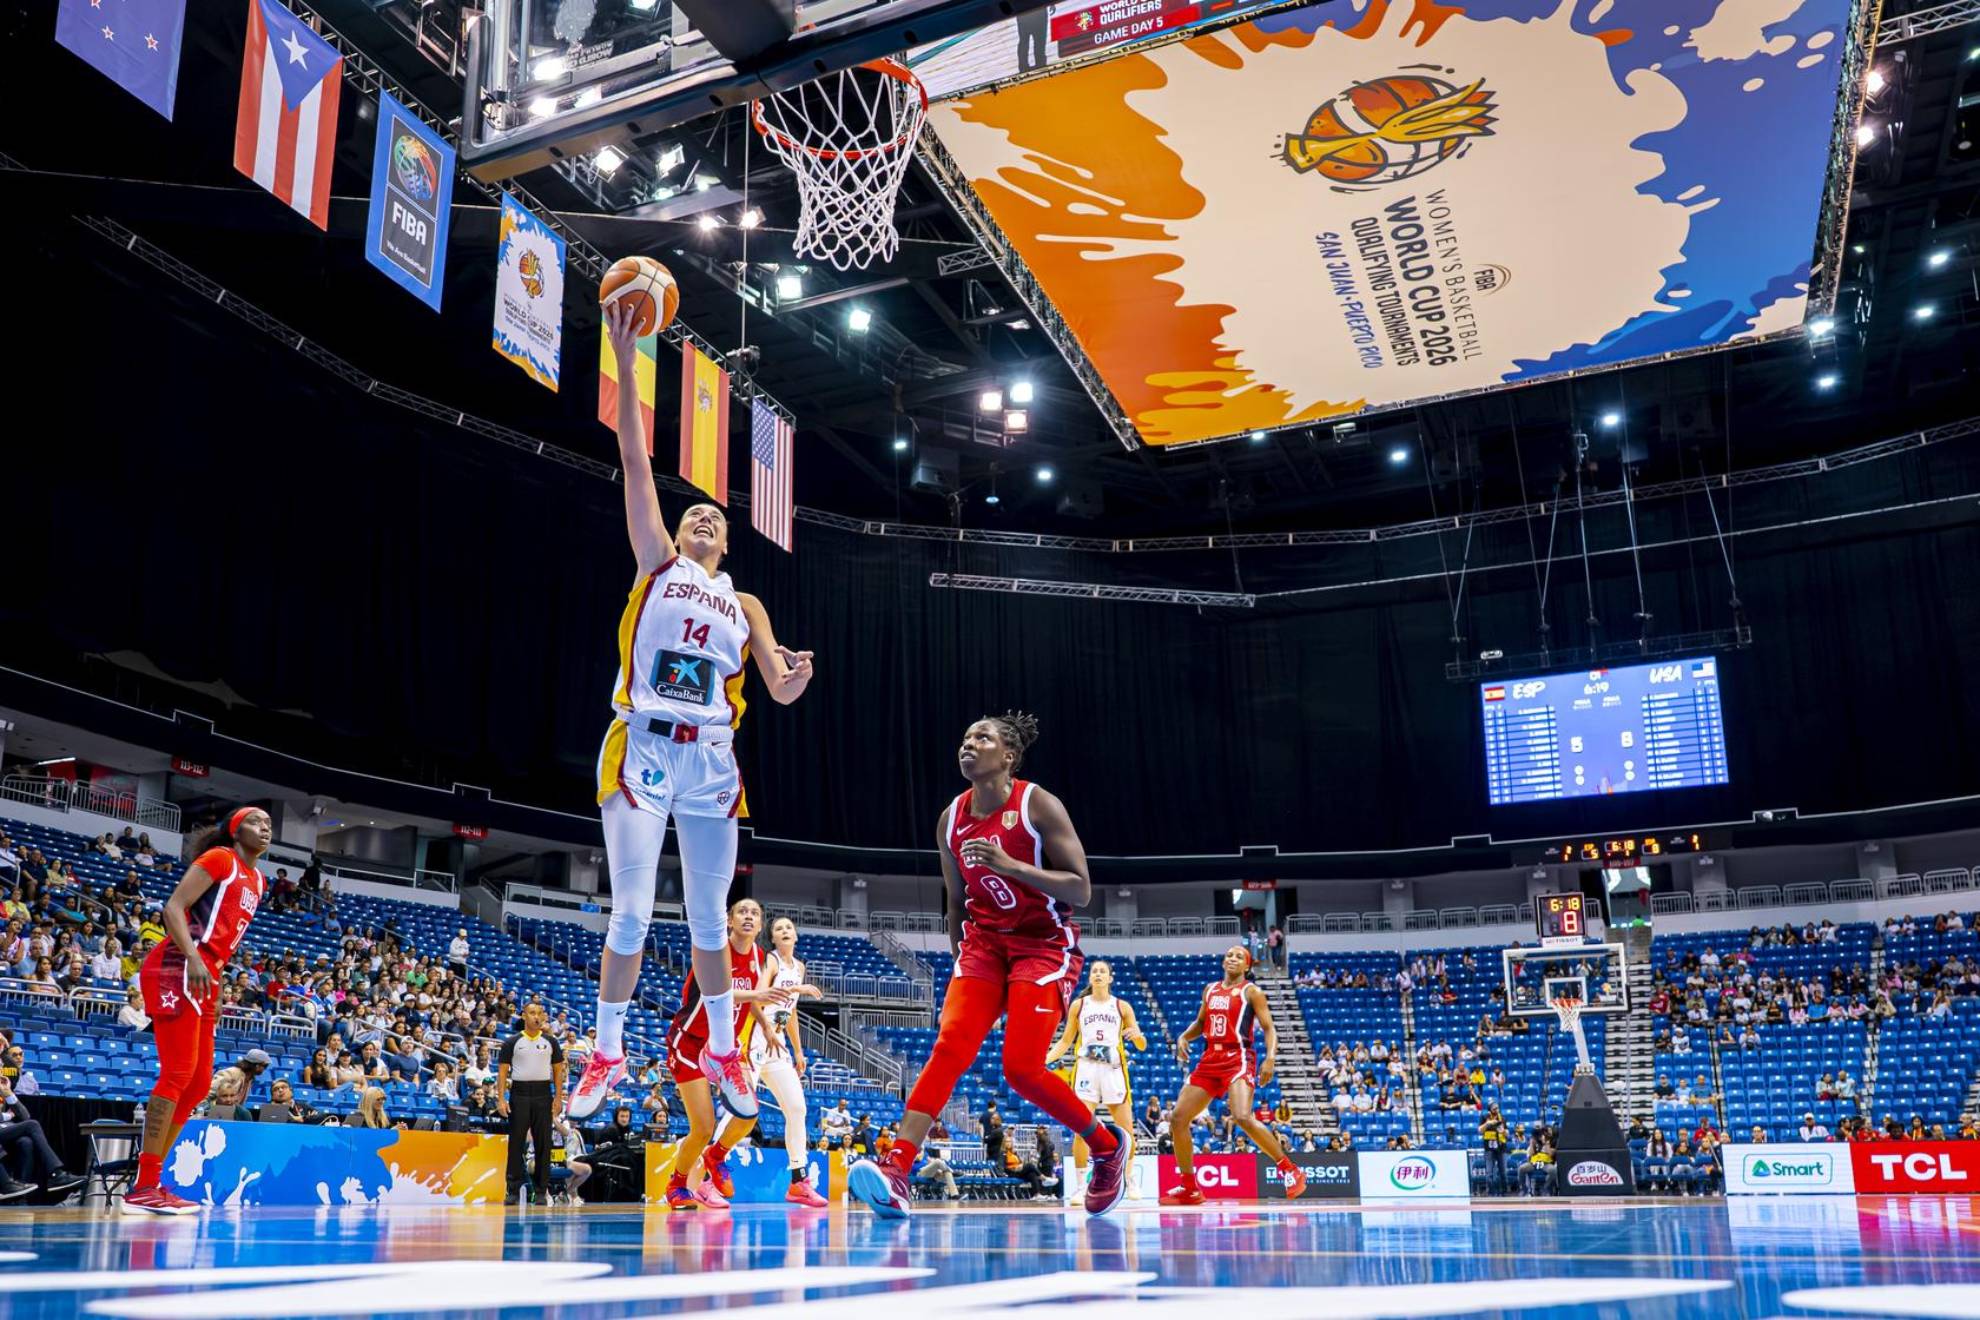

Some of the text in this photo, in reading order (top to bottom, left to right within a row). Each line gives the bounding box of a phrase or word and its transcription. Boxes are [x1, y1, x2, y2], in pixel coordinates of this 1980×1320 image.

[1100, 0, 1162, 25] QUALIFIERS
[1094, 16, 1164, 45] GAME DAY 5
[392, 201, 427, 246] FIBA
[1315, 231, 1346, 259] SAN
[1384, 195, 1458, 367] WORLD CUP 2026
[1424, 188, 1482, 361] WOMEN'S BASKETBALL
[1473, 268, 1497, 292] FIBA
[1351, 216, 1420, 367] QUALIFYING TOURNAMENTS
[683, 617, 711, 649] 14
[1512, 664, 1683, 699] ESP USA
[1584, 682, 1610, 695] 6:19
[656, 684, 705, 704] CaixaBank
[1571, 736, 1583, 753] 5
[1590, 849, 1599, 860] 5
[1611, 839, 1635, 852] 6:18
[981, 874, 1017, 910] 8
[1550, 897, 1580, 912] 6:18
[230, 917, 249, 950] 7
[1563, 910, 1578, 933] 8
[1209, 995, 1229, 1010] USA
[1096, 1029, 1105, 1041] 5
[1209, 1014, 1227, 1037] 13
[1396, 1165, 1429, 1180] 伊利
[1772, 1161, 1824, 1177] Smart
[1870, 1152, 1968, 1181] TCL
